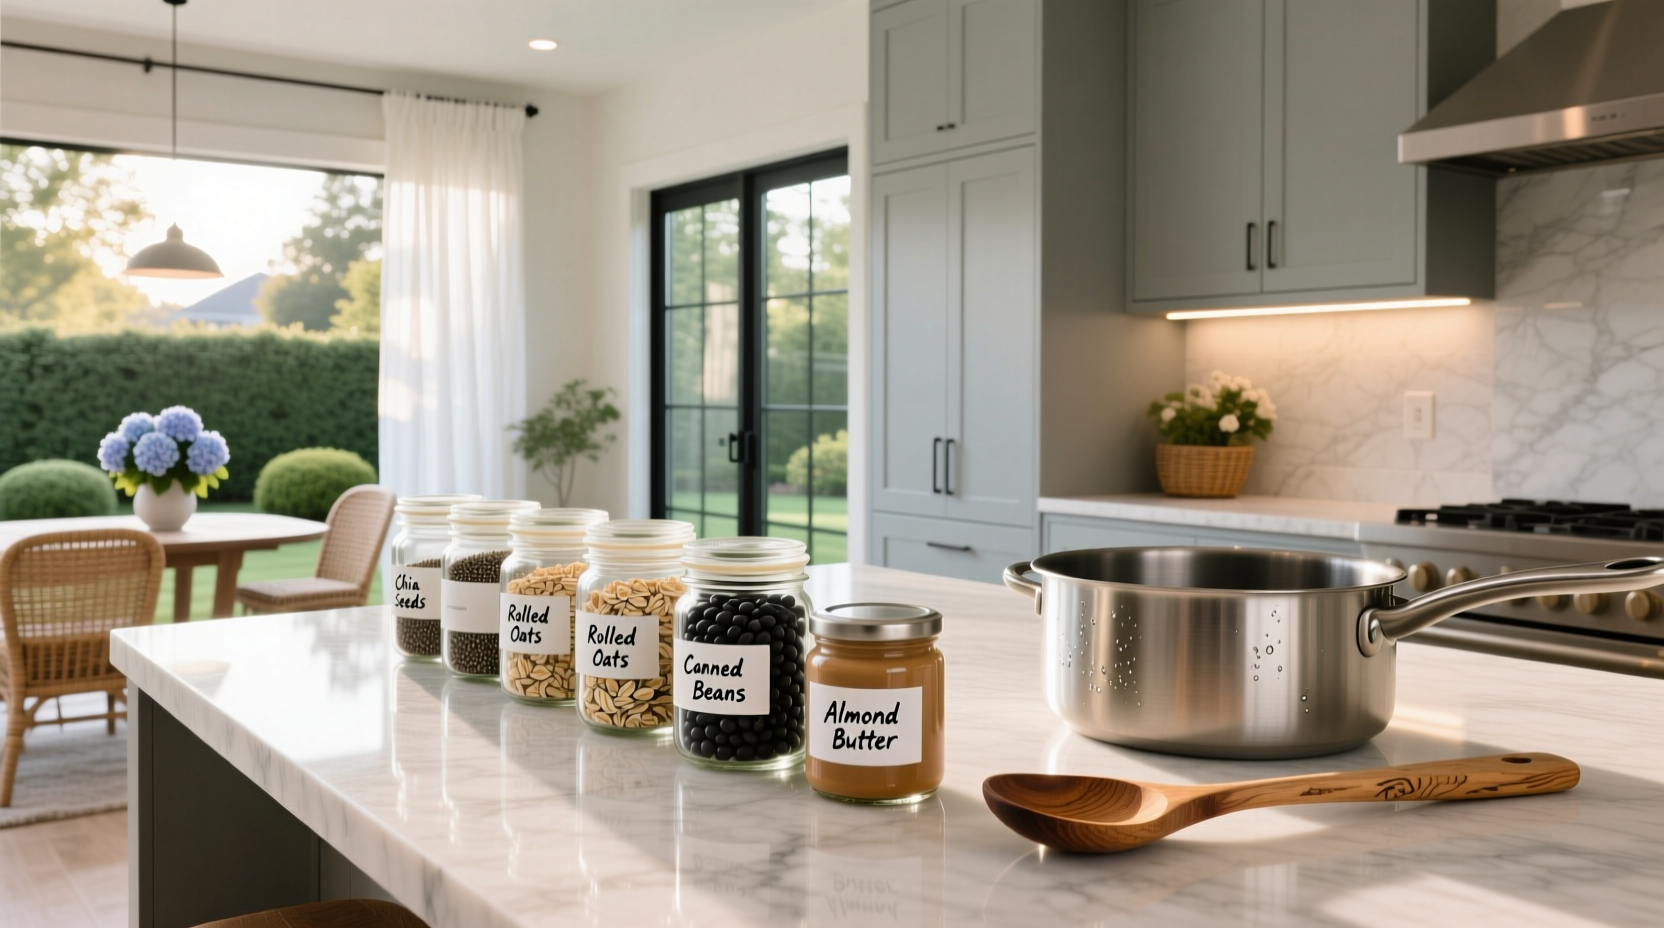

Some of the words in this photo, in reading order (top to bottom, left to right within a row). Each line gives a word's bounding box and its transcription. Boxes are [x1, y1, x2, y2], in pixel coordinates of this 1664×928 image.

[395, 573, 420, 591] Chia
[394, 593, 426, 609] Seeds
[508, 604, 550, 624] Rolled
[510, 625, 542, 644] Oats
[587, 624, 637, 646] Rolled
[592, 648, 629, 668] Oats
[683, 654, 744, 678] Canned
[692, 680, 746, 702] Beans
[823, 700, 900, 725] Almond
[832, 728, 898, 750] Butter
